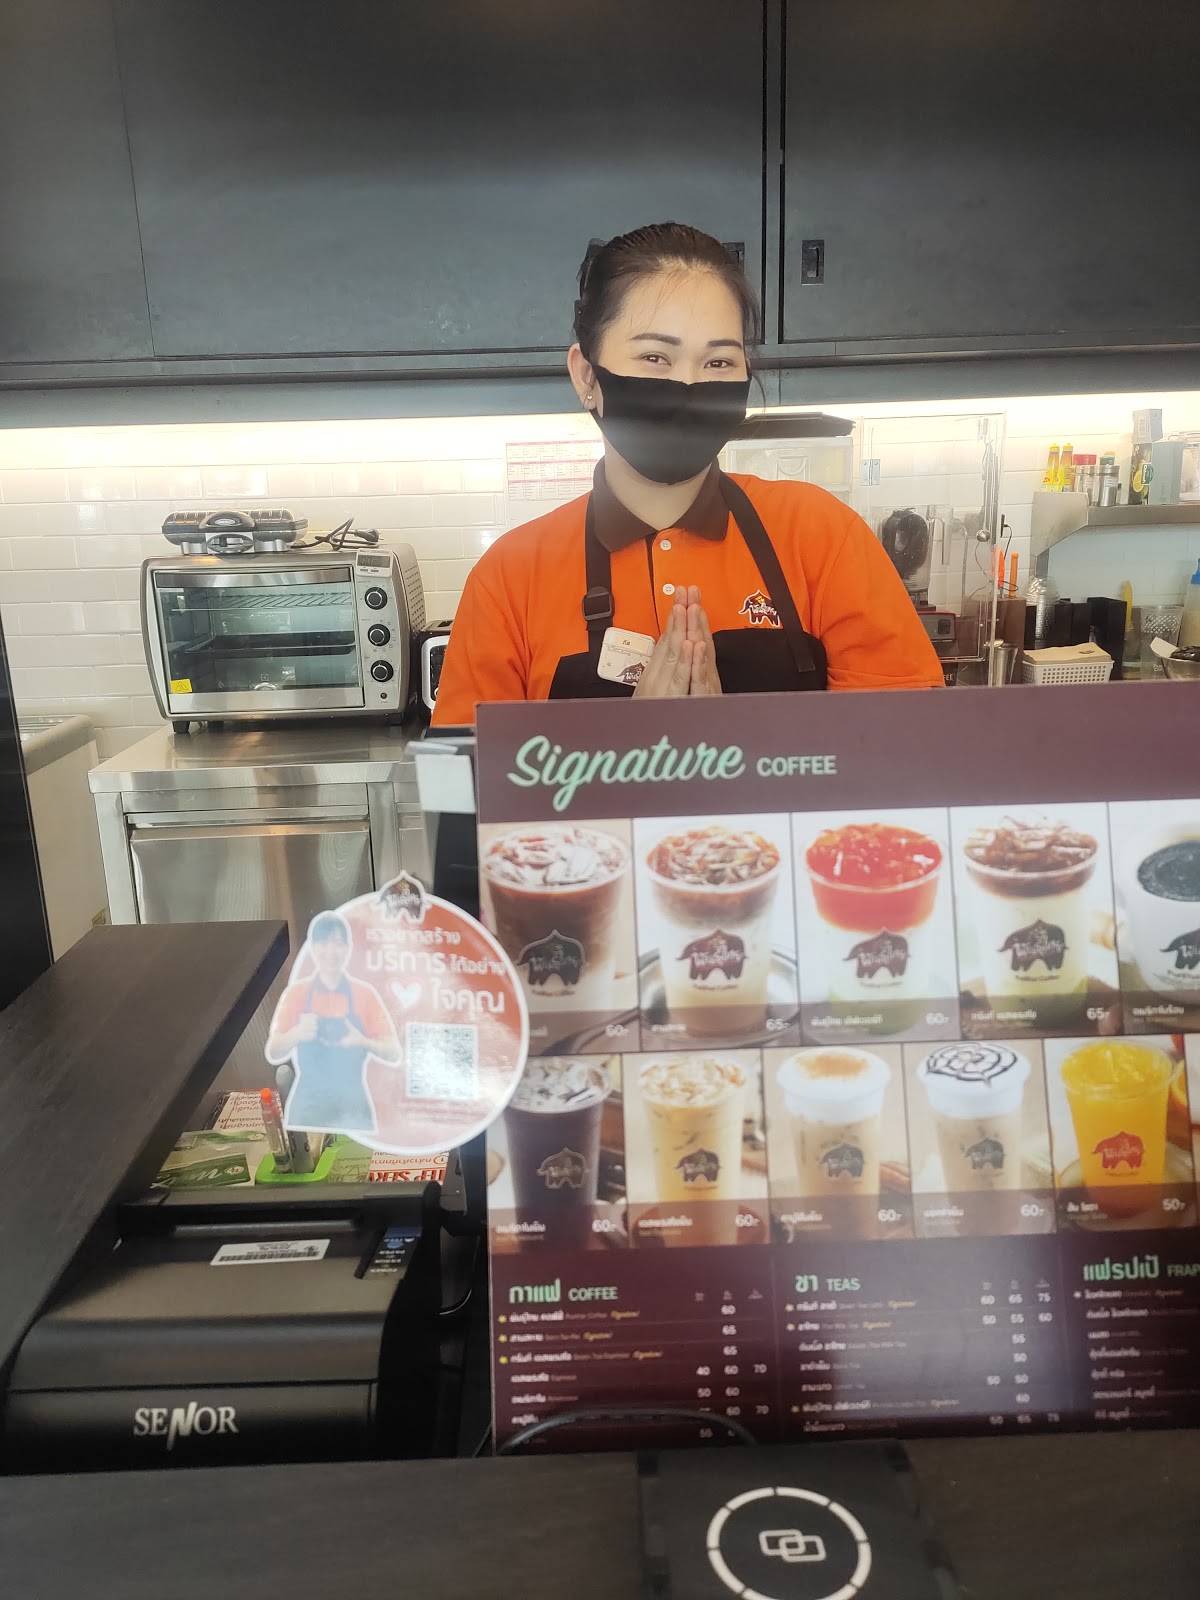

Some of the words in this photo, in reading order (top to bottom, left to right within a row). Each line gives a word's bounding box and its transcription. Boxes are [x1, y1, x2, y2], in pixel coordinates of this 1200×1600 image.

[507, 735, 746, 812] Signature
[756, 755, 837, 778] COFFEE
[366, 944, 447, 974] บริการ
[431, 977, 505, 1021] ใจคุณ
[509, 1278, 561, 1304] กาแฟ
[568, 1286, 618, 1301] COFFEE
[795, 1274, 818, 1293] ชา
[826, 1277, 861, 1292] TEAS
[1037, 1292, 1051, 1303] 75
[1010, 1313, 1024, 1324] 55
[696, 1366, 711, 1376] 40
[754, 1363, 768, 1374] 70
[756, 1404, 770, 1415] 70
[133, 1401, 239, 1451] SENOR
